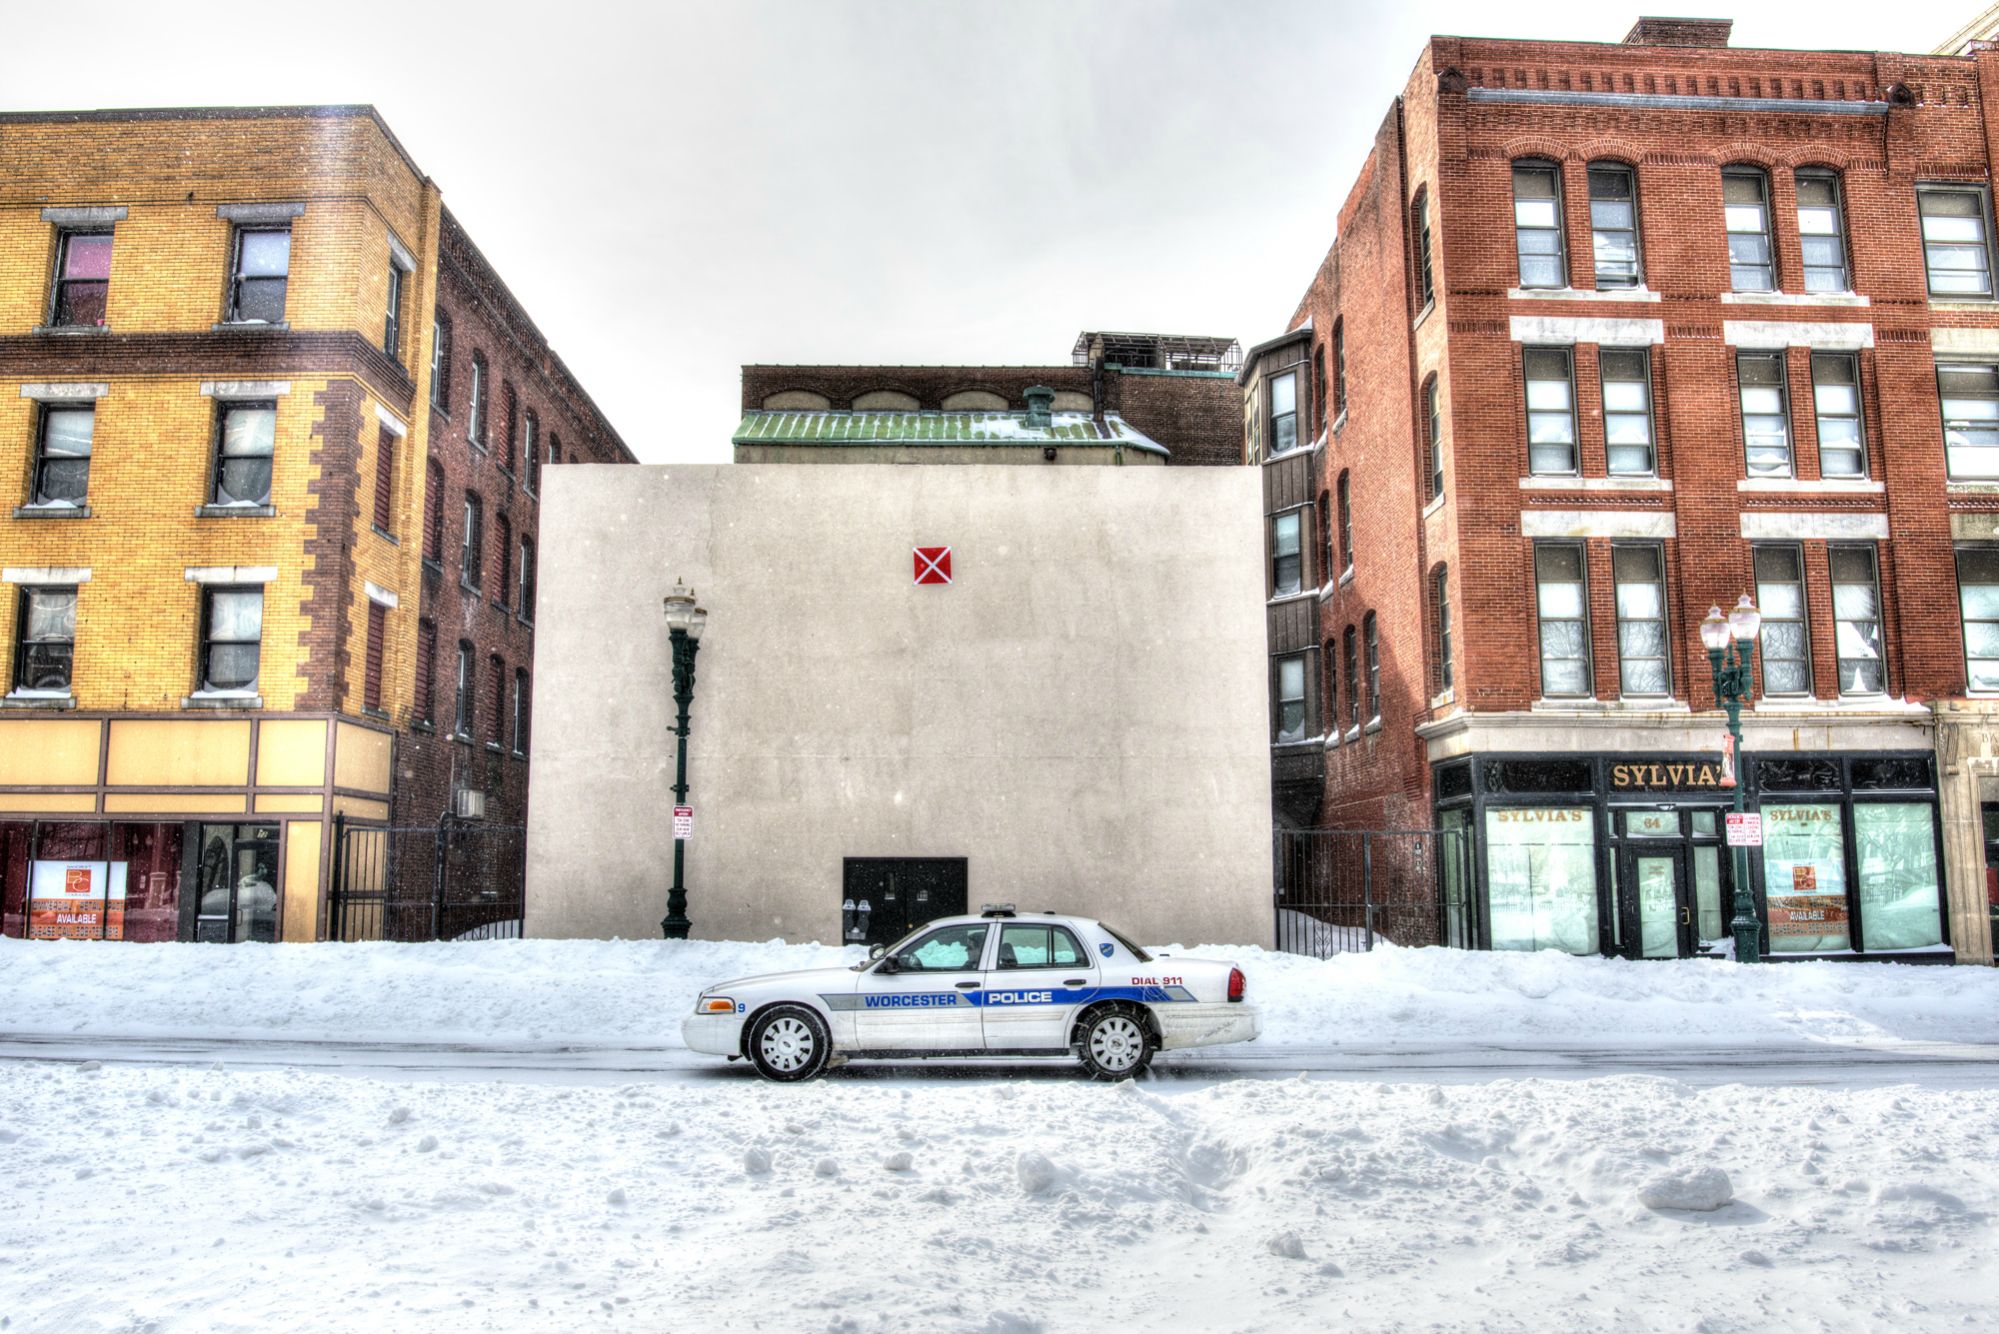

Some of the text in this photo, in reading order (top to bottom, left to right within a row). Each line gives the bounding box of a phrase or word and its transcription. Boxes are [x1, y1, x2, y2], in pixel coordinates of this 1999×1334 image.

[1613, 765, 1721, 786] SYLVIA'
[1498, 809, 1583, 822] SYLVIA'S
[1770, 809, 1832, 822] SYLVIA'S
[1643, 817, 1661, 829] 64
[56, 913, 97, 924] AVAILABLE
[1789, 910, 1825, 921] AVAILABLE
[1131, 976, 1183, 985] DIAL 911
[865, 991, 1053, 1007] WORCESTER POLICE
[737, 1003, 746, 1013] 9
